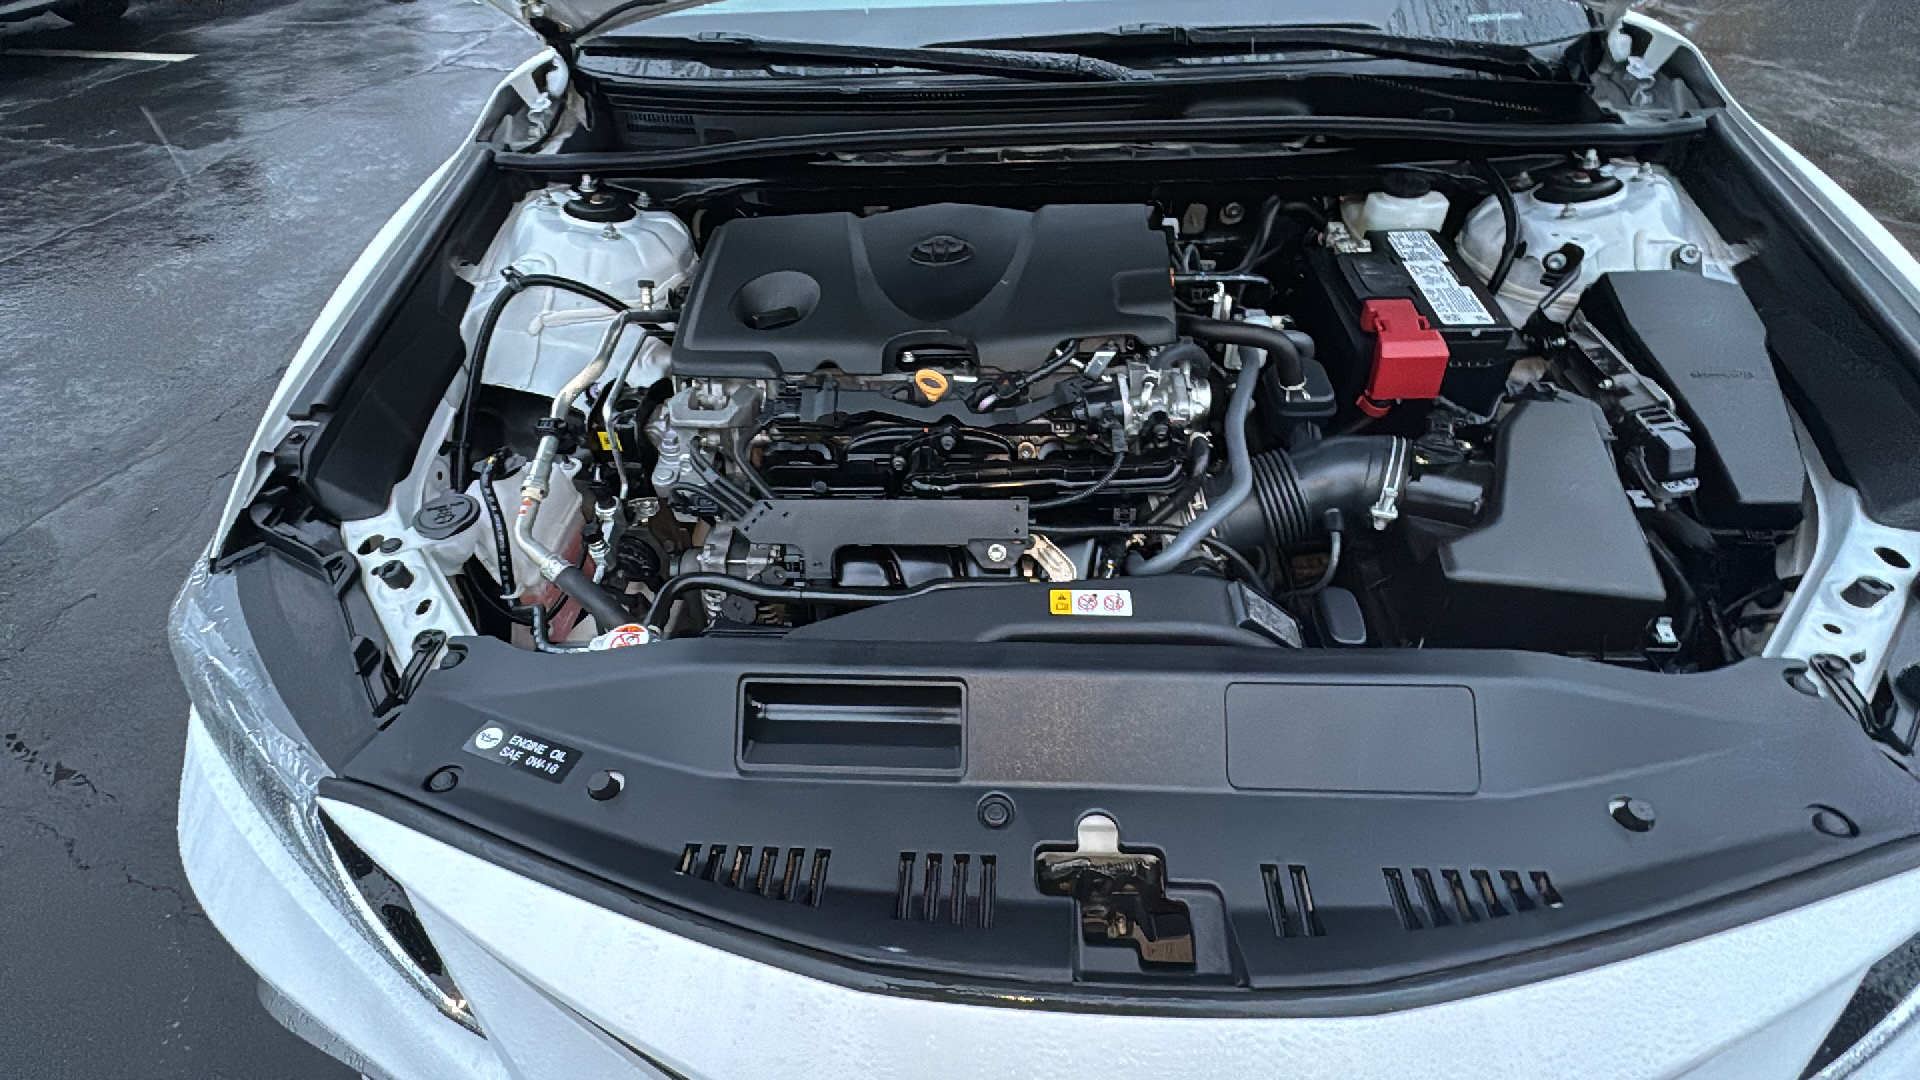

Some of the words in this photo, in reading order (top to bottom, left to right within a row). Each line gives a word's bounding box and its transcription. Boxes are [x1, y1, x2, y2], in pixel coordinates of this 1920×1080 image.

[499, 746, 524, 761] SAE
[525, 755, 560, 775] 0W-16
[508, 734, 549, 755] ENGINE
[549, 749, 567, 763] OIL
